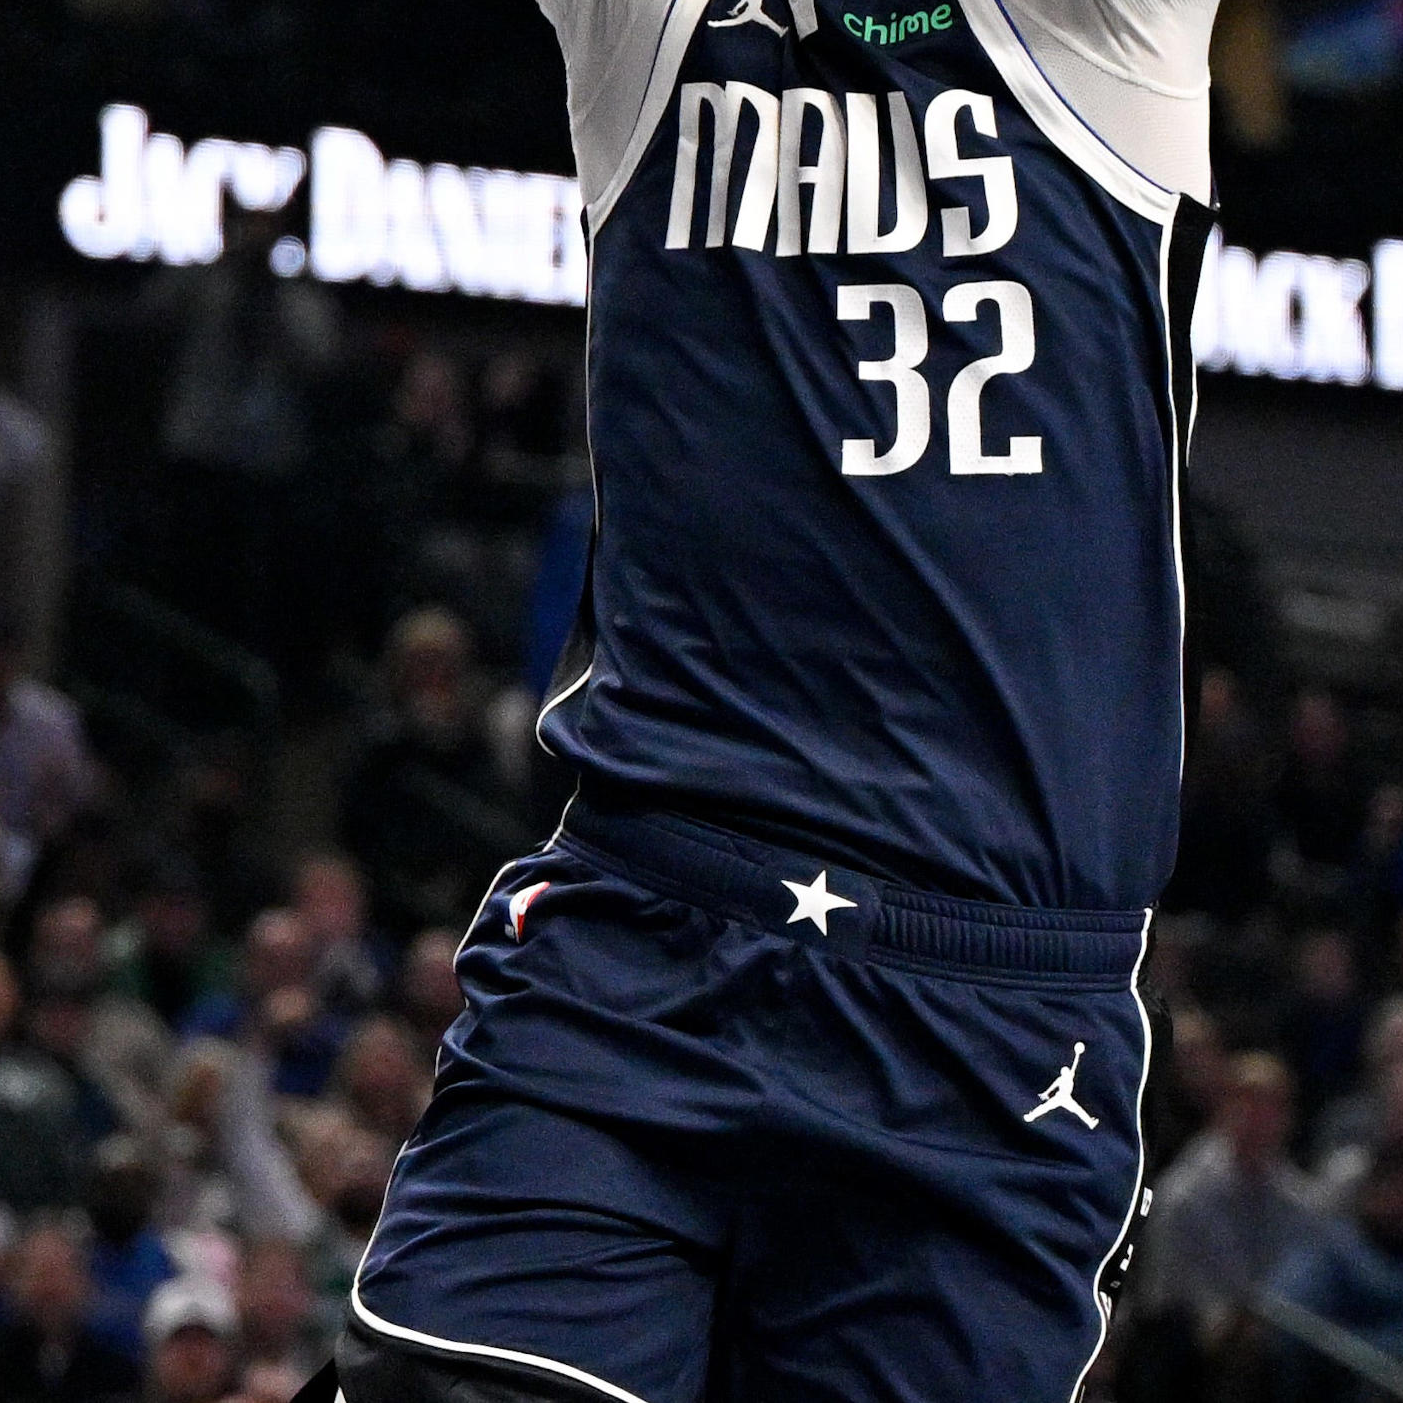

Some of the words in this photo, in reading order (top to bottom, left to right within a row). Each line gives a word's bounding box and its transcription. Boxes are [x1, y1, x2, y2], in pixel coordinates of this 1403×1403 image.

[843, 3, 953, 45] chime
[665, 81, 1019, 258] MAVS
[837, 280, 1043, 477] 32
